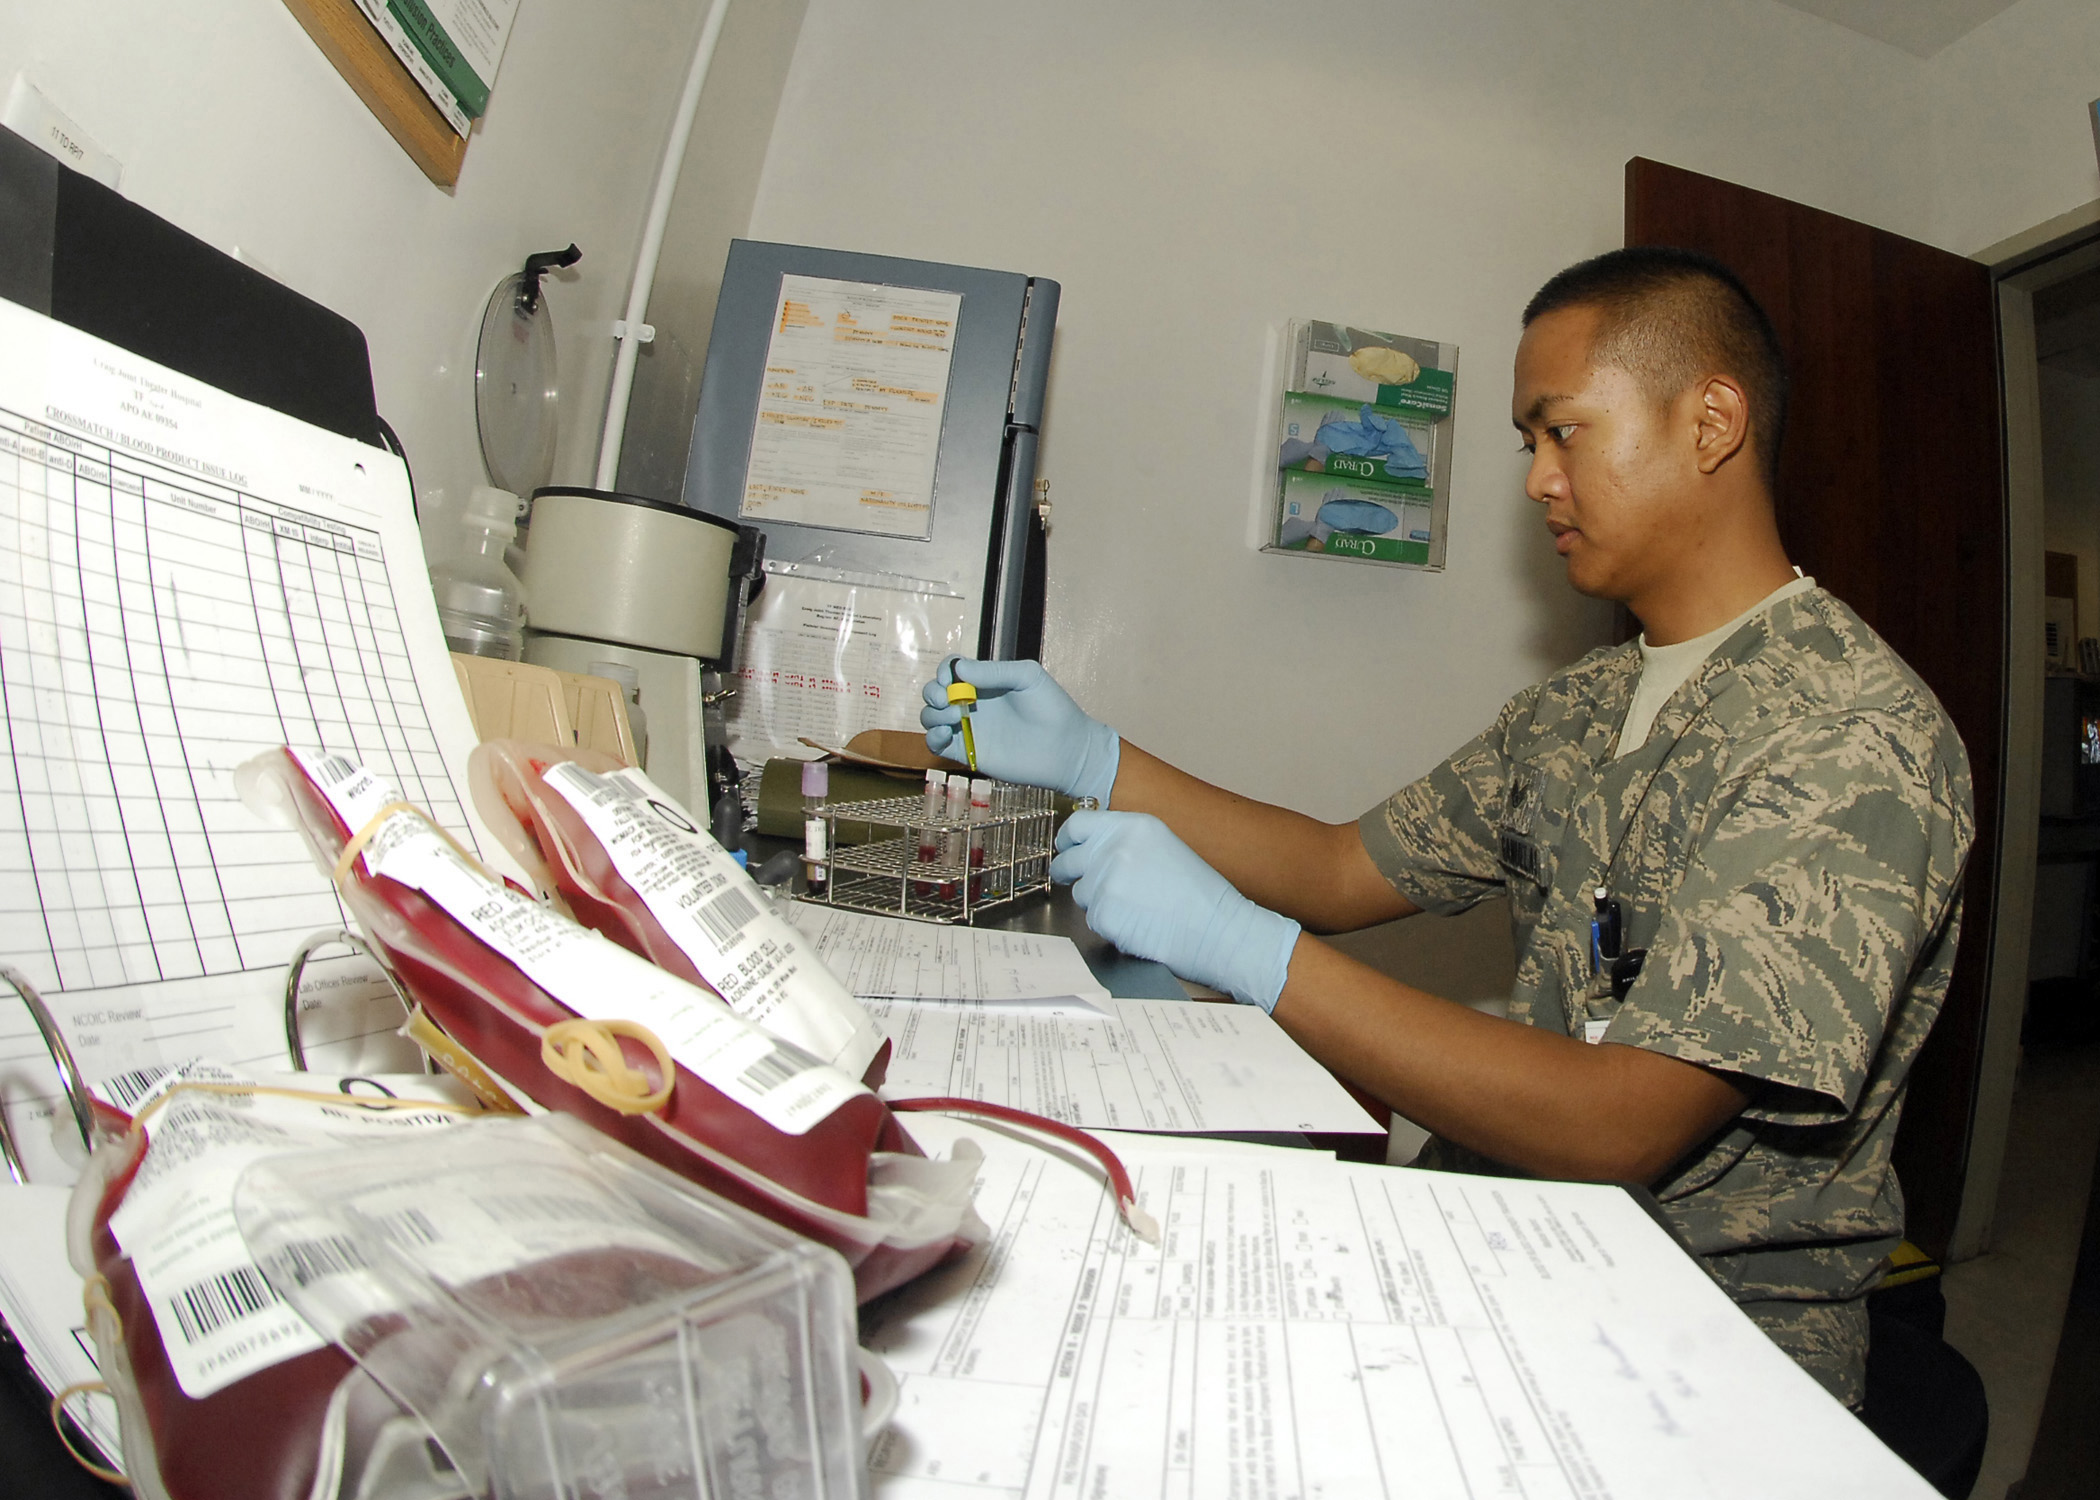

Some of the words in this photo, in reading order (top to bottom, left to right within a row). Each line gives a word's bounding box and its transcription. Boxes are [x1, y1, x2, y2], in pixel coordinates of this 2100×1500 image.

[425, 23, 456, 68] Practices
[120, 401, 139, 416] APO
[24, 421, 52, 440] Patient
[46, 404, 113, 440] CROSSMATCH
[121, 432, 154, 453] BLOOD
[156, 447, 200, 471] PRODUCT
[202, 462, 226, 479] ISSUE
[229, 470, 248, 485] LOG
[49, 455, 73, 469] anti-D
[1334, 458, 1374, 477] CURAD
[171, 493, 187, 506] Unit
[188, 498, 217, 514] Number
[322, 520, 346, 536] Testing
[1336, 538, 1376, 556] CURAD
[676, 879, 713, 909] VOLUNTEER
[471, 900, 504, 924] RED
[341, 974, 369, 987] Review
[717, 972, 739, 994] RED
[737, 951, 764, 977] BLOOD
[303, 1000, 322, 1012] Date
[72, 1011, 107, 1028] NCOIC
[78, 1034, 99, 1048] Date
